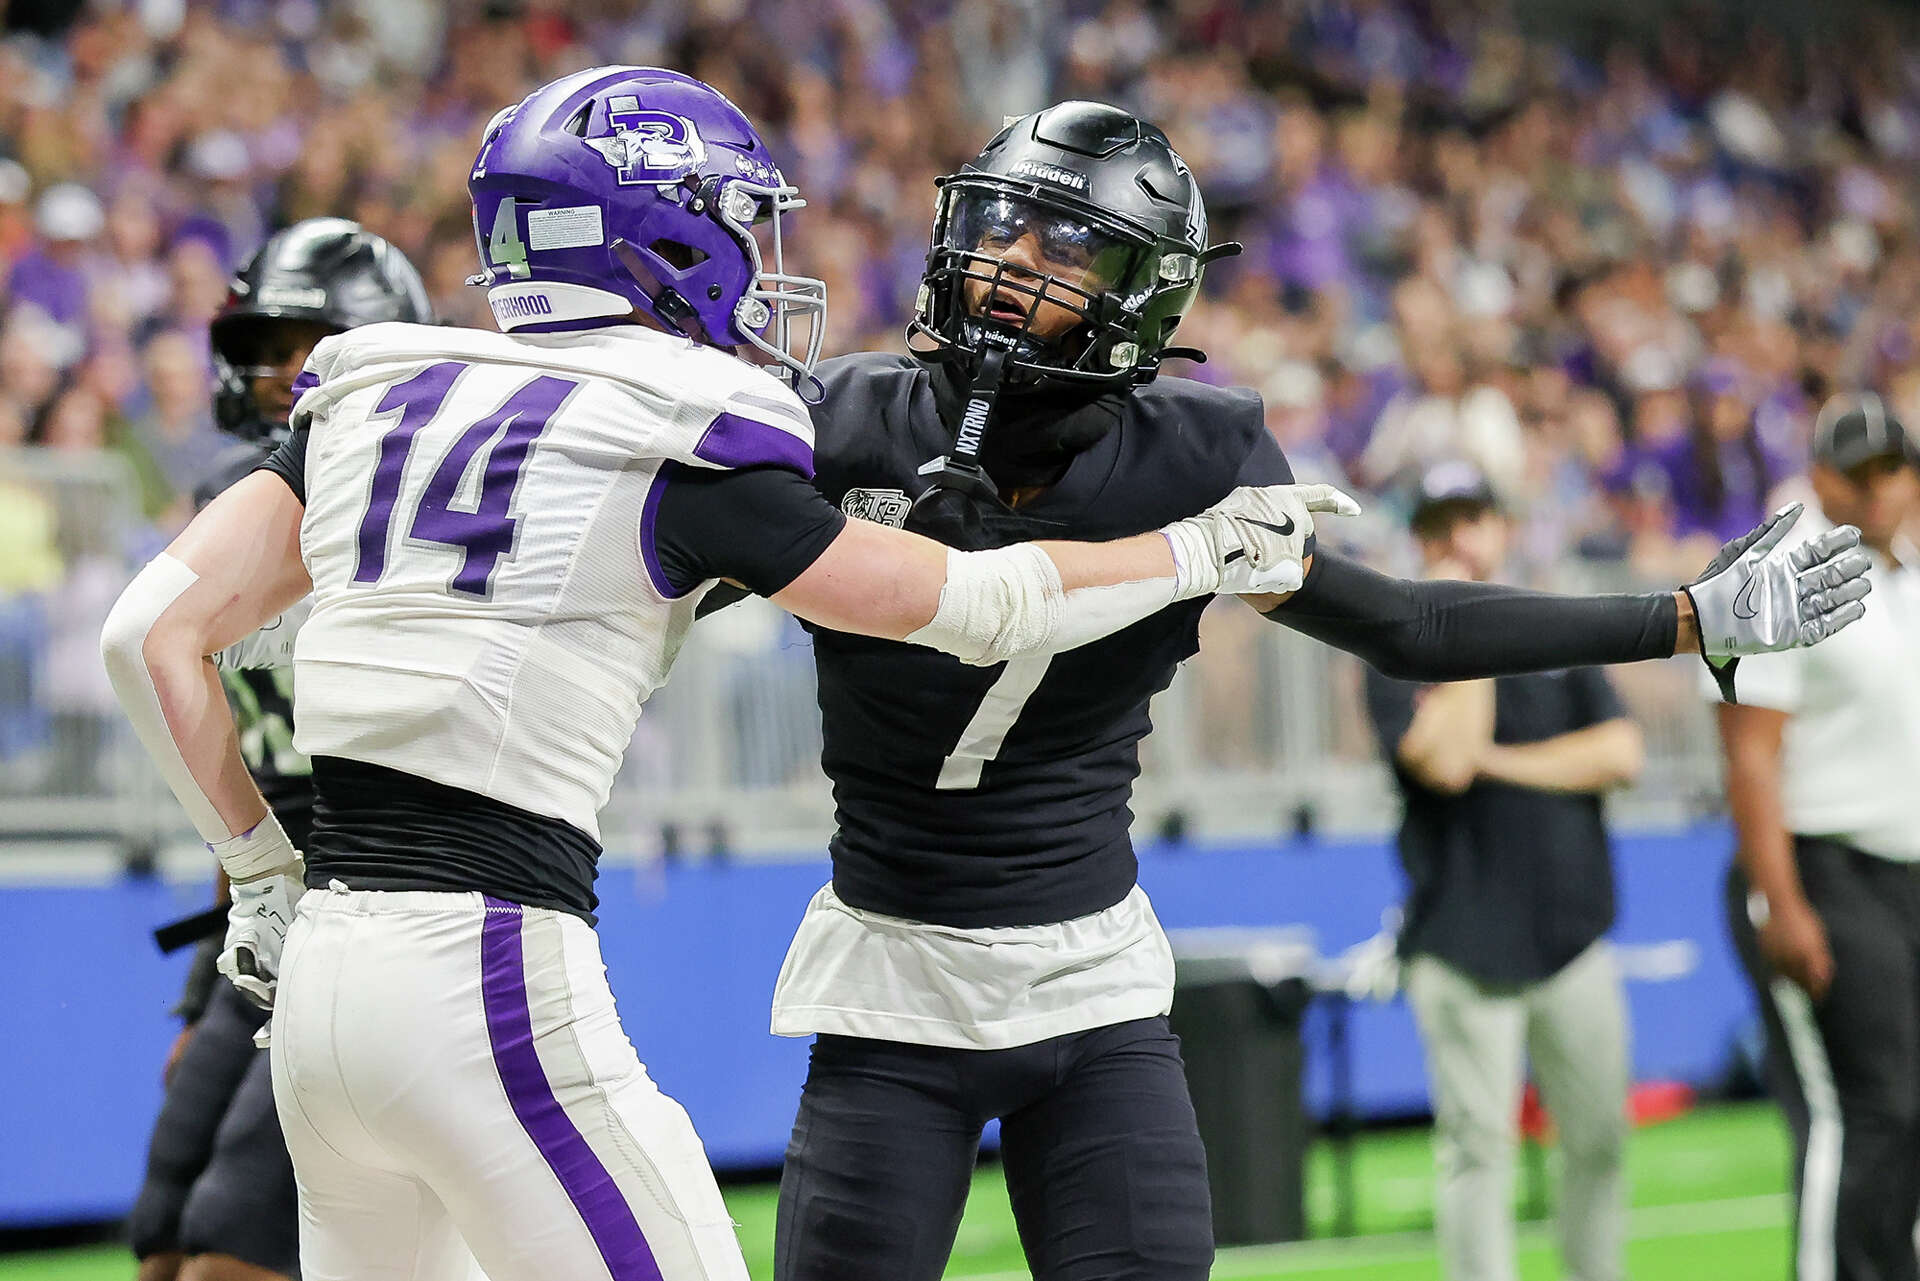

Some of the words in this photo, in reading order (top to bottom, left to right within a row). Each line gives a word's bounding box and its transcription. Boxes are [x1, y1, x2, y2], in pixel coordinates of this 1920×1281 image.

[1019, 162, 1085, 190] Riddell
[489, 196, 532, 280] 4
[547, 208, 576, 216] WARNING
[954, 398, 991, 456] NXTRND
[346, 360, 591, 603] 14
